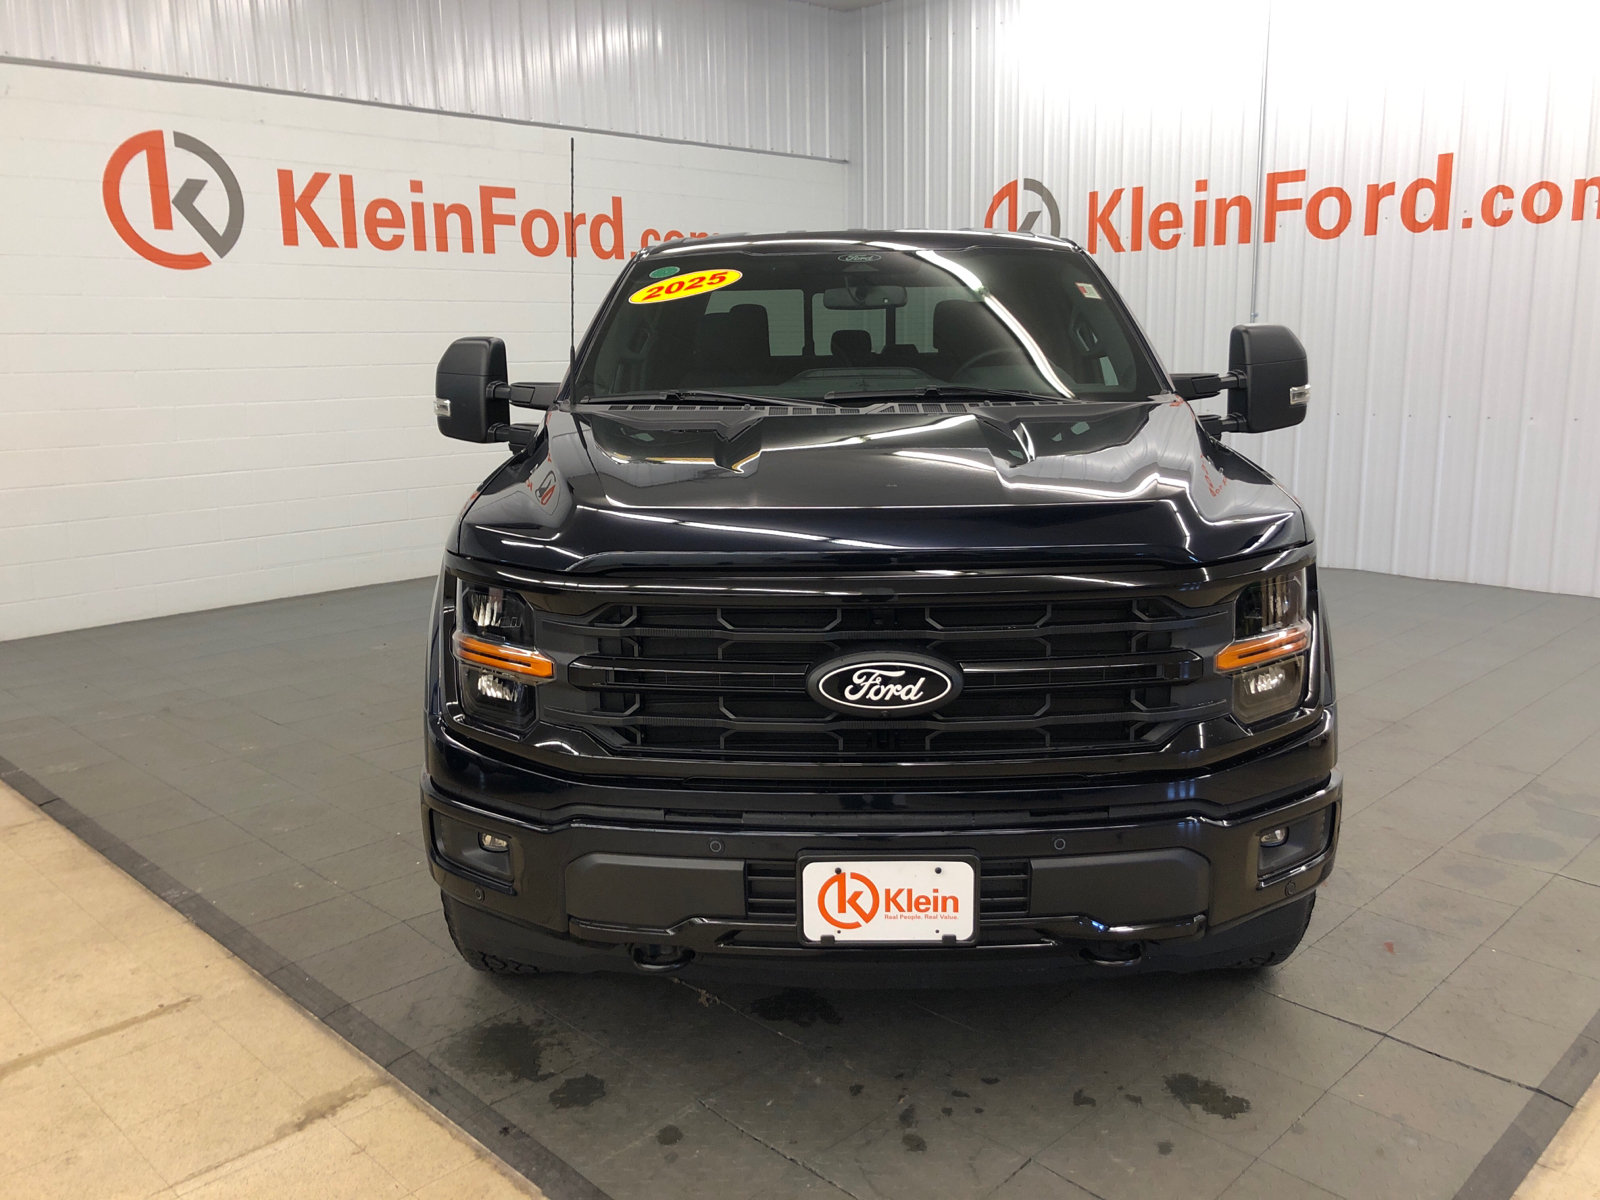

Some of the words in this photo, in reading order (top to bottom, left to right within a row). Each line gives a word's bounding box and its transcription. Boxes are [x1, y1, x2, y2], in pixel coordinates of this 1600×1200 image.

[277, 168, 719, 260] KleinFord.c
[641, 271, 729, 301] 2025
[844, 668, 926, 700] Ford
[884, 888, 959, 913] Klein
